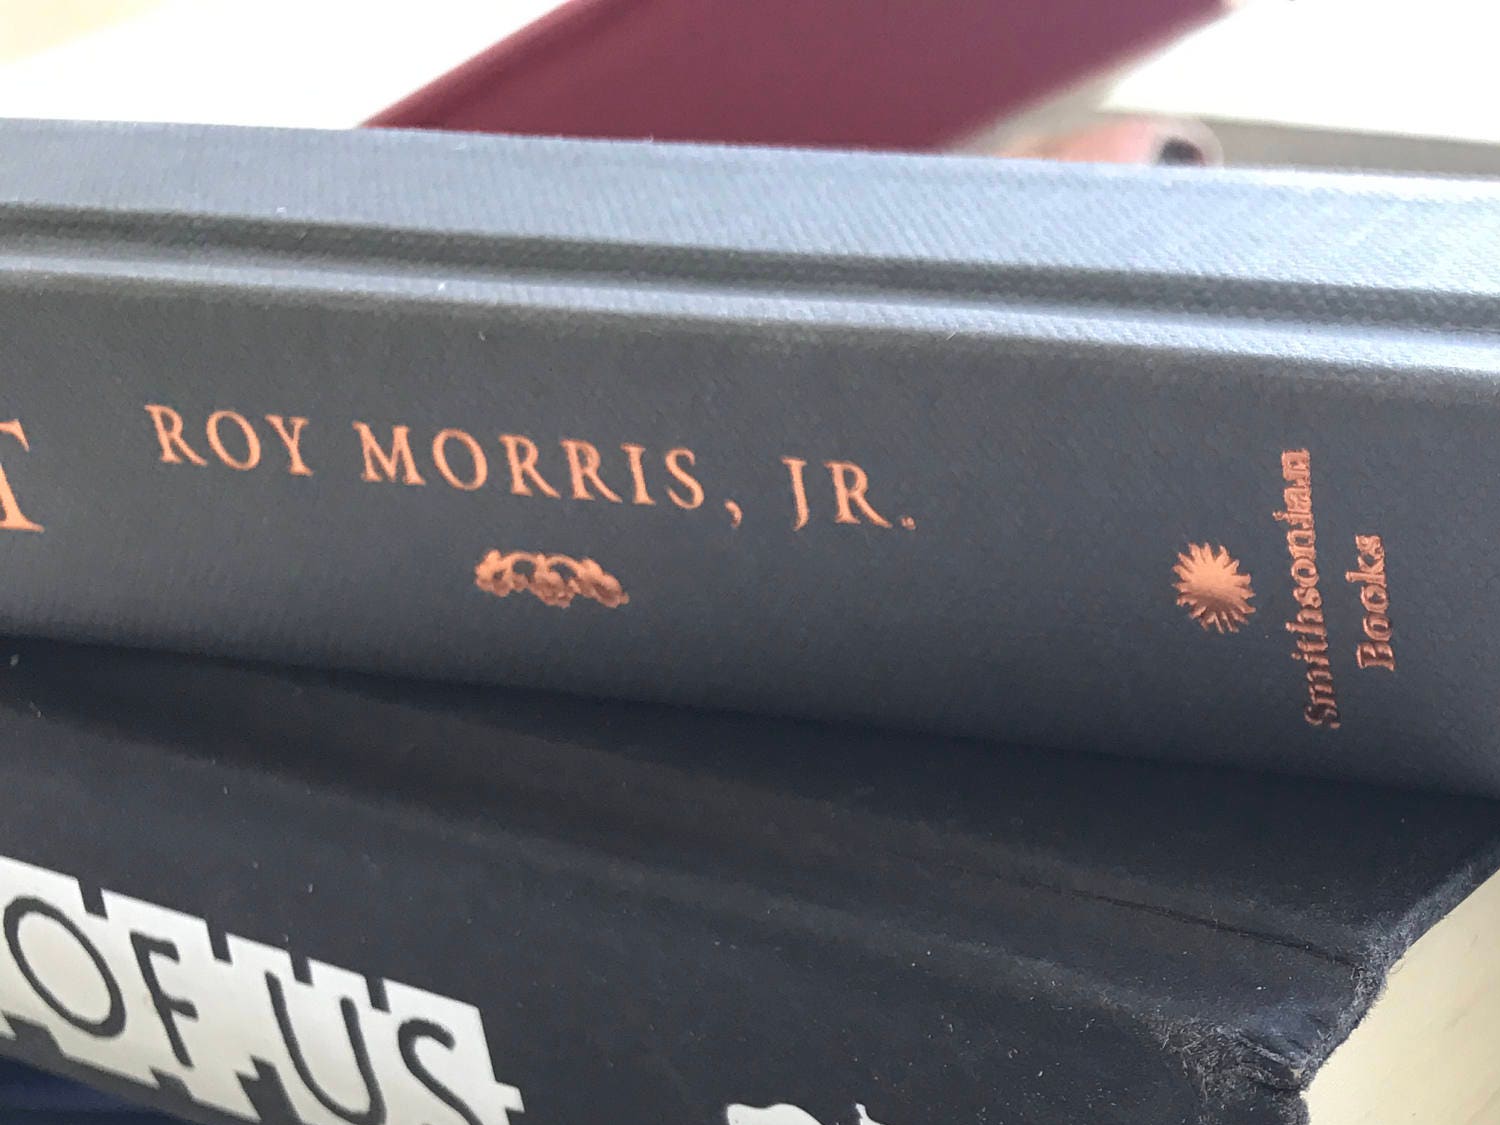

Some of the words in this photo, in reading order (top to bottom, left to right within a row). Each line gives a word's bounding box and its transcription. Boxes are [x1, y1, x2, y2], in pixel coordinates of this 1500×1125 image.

[143, 403, 315, 477] ROY
[352, 420, 743, 530] MORRIS,
[781, 455, 917, 532] JR.
[1271, 447, 1342, 731] Smithsonian
[1344, 533, 1397, 672] Books
[1, 893, 200, 1072] OF
